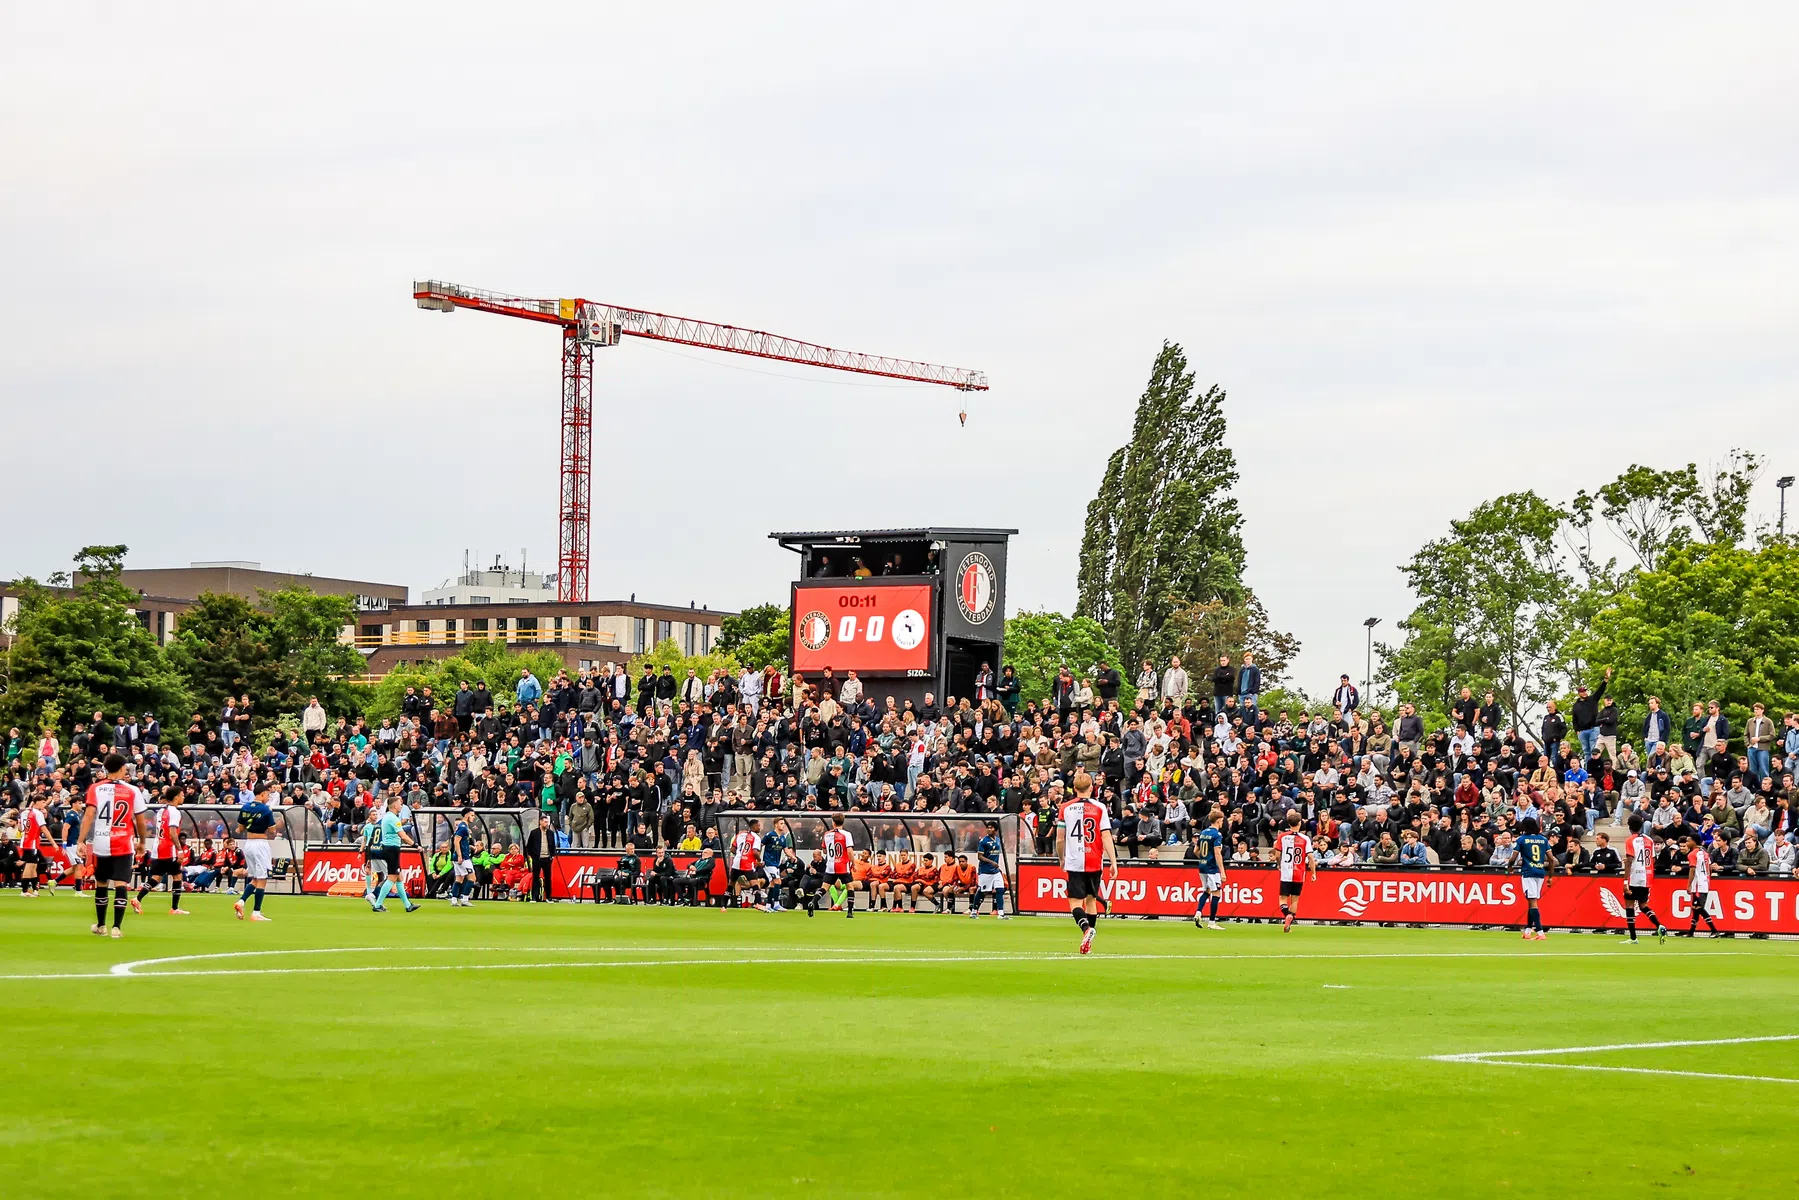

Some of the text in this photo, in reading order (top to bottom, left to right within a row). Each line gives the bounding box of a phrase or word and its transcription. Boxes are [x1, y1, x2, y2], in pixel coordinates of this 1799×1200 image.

[959, 555, 994, 580] FEYENOORD
[839, 595, 876, 608] 00:11
[958, 595, 994, 622] ROTTERDAM
[907, 669, 924, 677] SIZO
[98, 800, 127, 828] 42
[373, 828, 381, 845] 8
[1071, 818, 1097, 844] 43
[738, 841, 751, 856] 19
[829, 842, 844, 858] 60
[1284, 846, 1303, 865] 58
[1531, 844, 1541, 862] 9
[1637, 848, 1651, 867] 48
[1037, 878, 1264, 905] PRVRIJ vakaties
[1338, 878, 1516, 917] QTERMINALS
[1671, 889, 1799, 921] CAST
